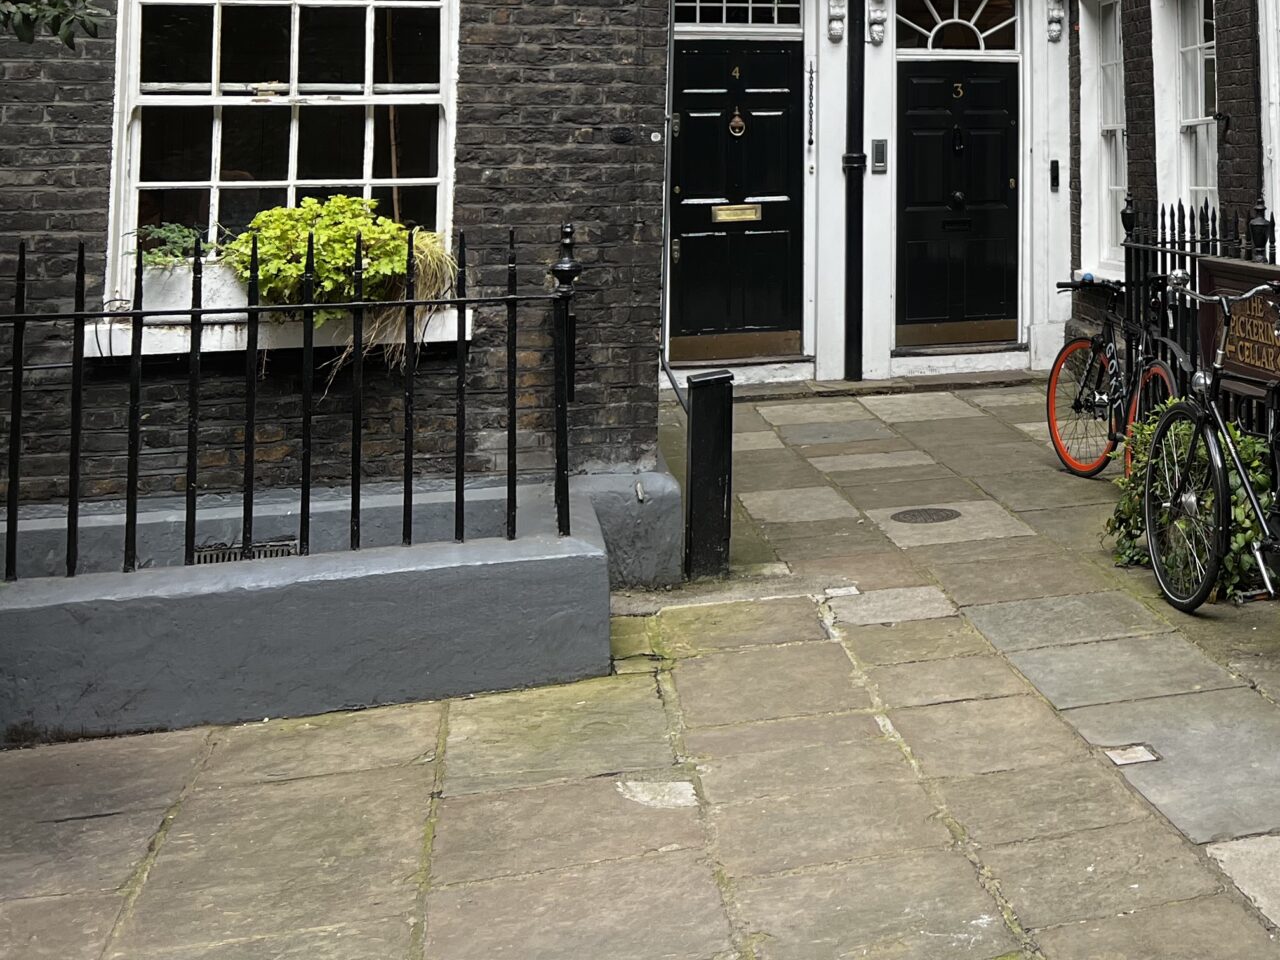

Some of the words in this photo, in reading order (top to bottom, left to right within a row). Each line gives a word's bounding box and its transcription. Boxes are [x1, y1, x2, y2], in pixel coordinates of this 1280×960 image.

[731, 66, 740, 80] 4
[952, 83, 964, 99] 3
[1246, 296, 1265, 318] THE
[1238, 341, 1275, 371] CELLAR
